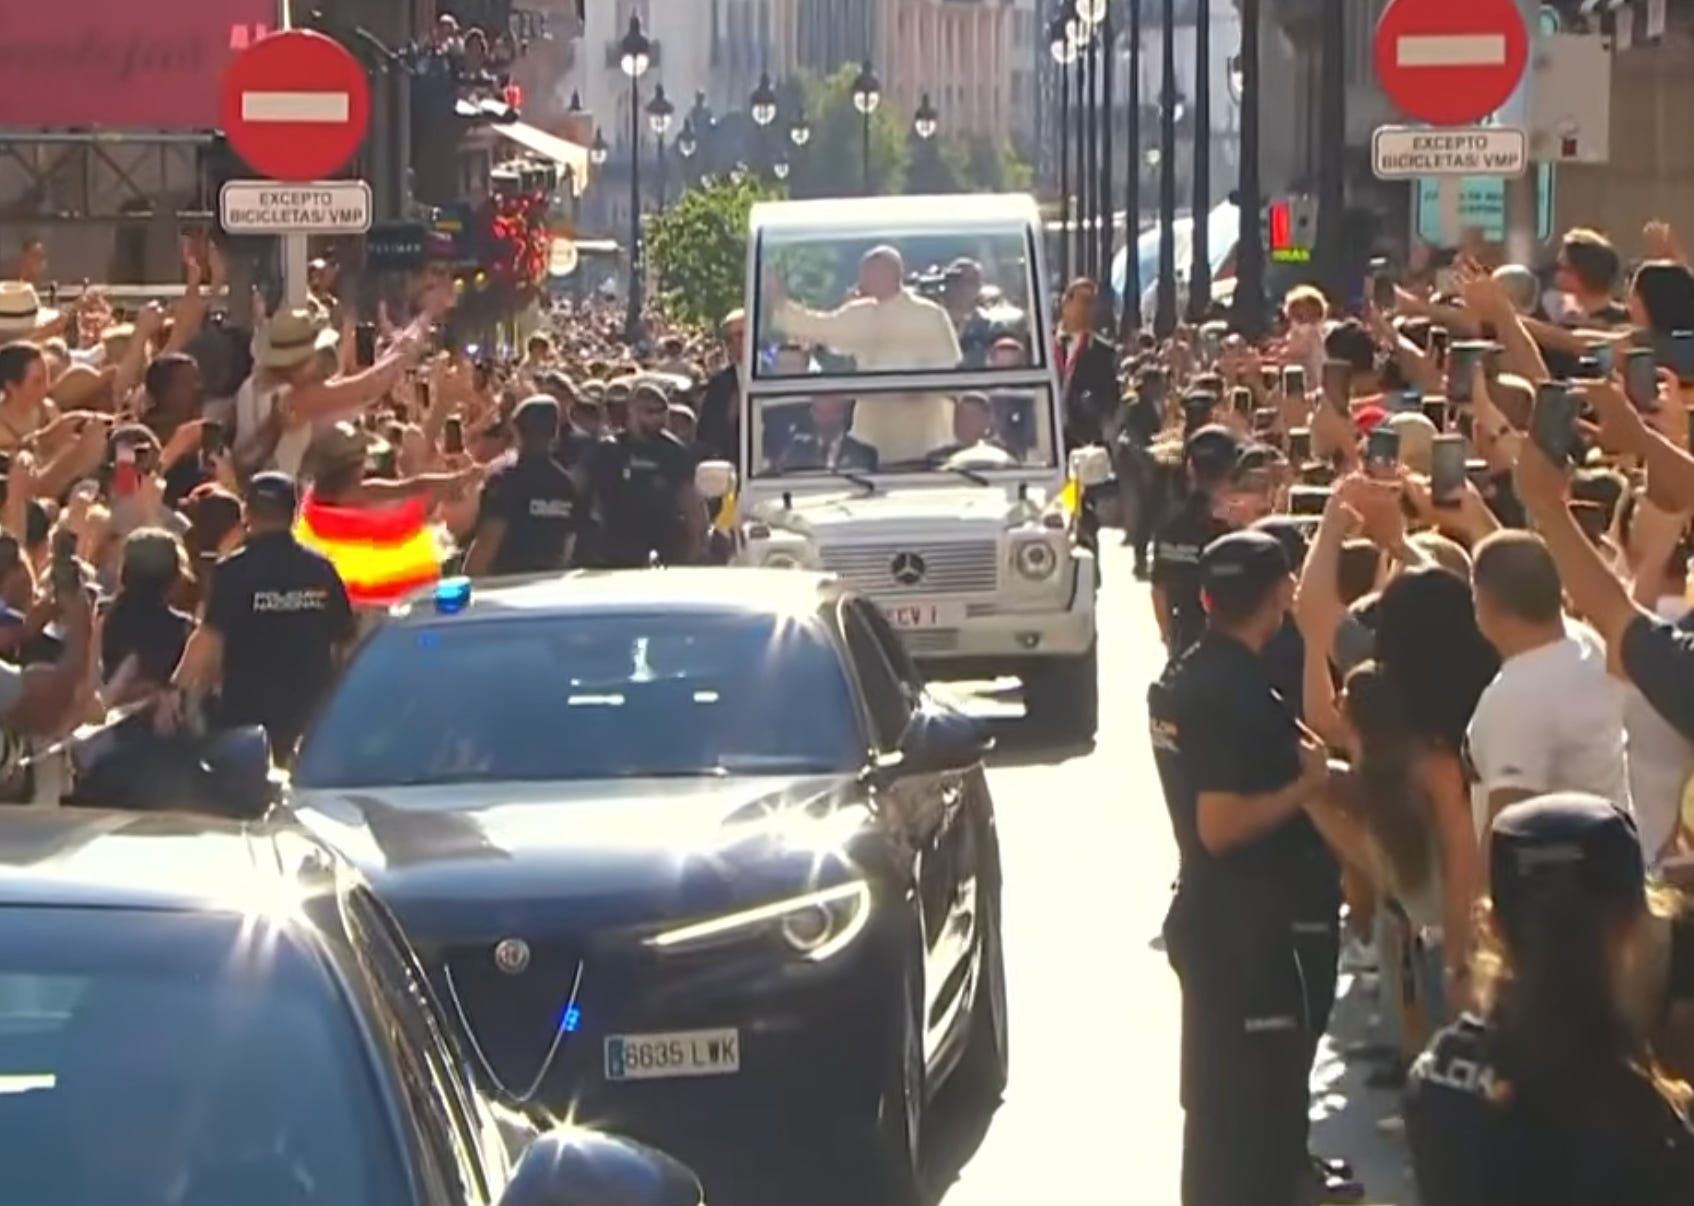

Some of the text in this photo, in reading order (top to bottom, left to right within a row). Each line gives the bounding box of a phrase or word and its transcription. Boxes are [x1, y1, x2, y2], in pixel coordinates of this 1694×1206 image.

[1413, 136, 1488, 150] EXCEPTO
[1483, 153, 1519, 168] VMP
[259, 192, 333, 206] EXCEPTO
[230, 208, 363, 223] BICICLETAS/ VMP
[691, 1037, 735, 1066] LWK
